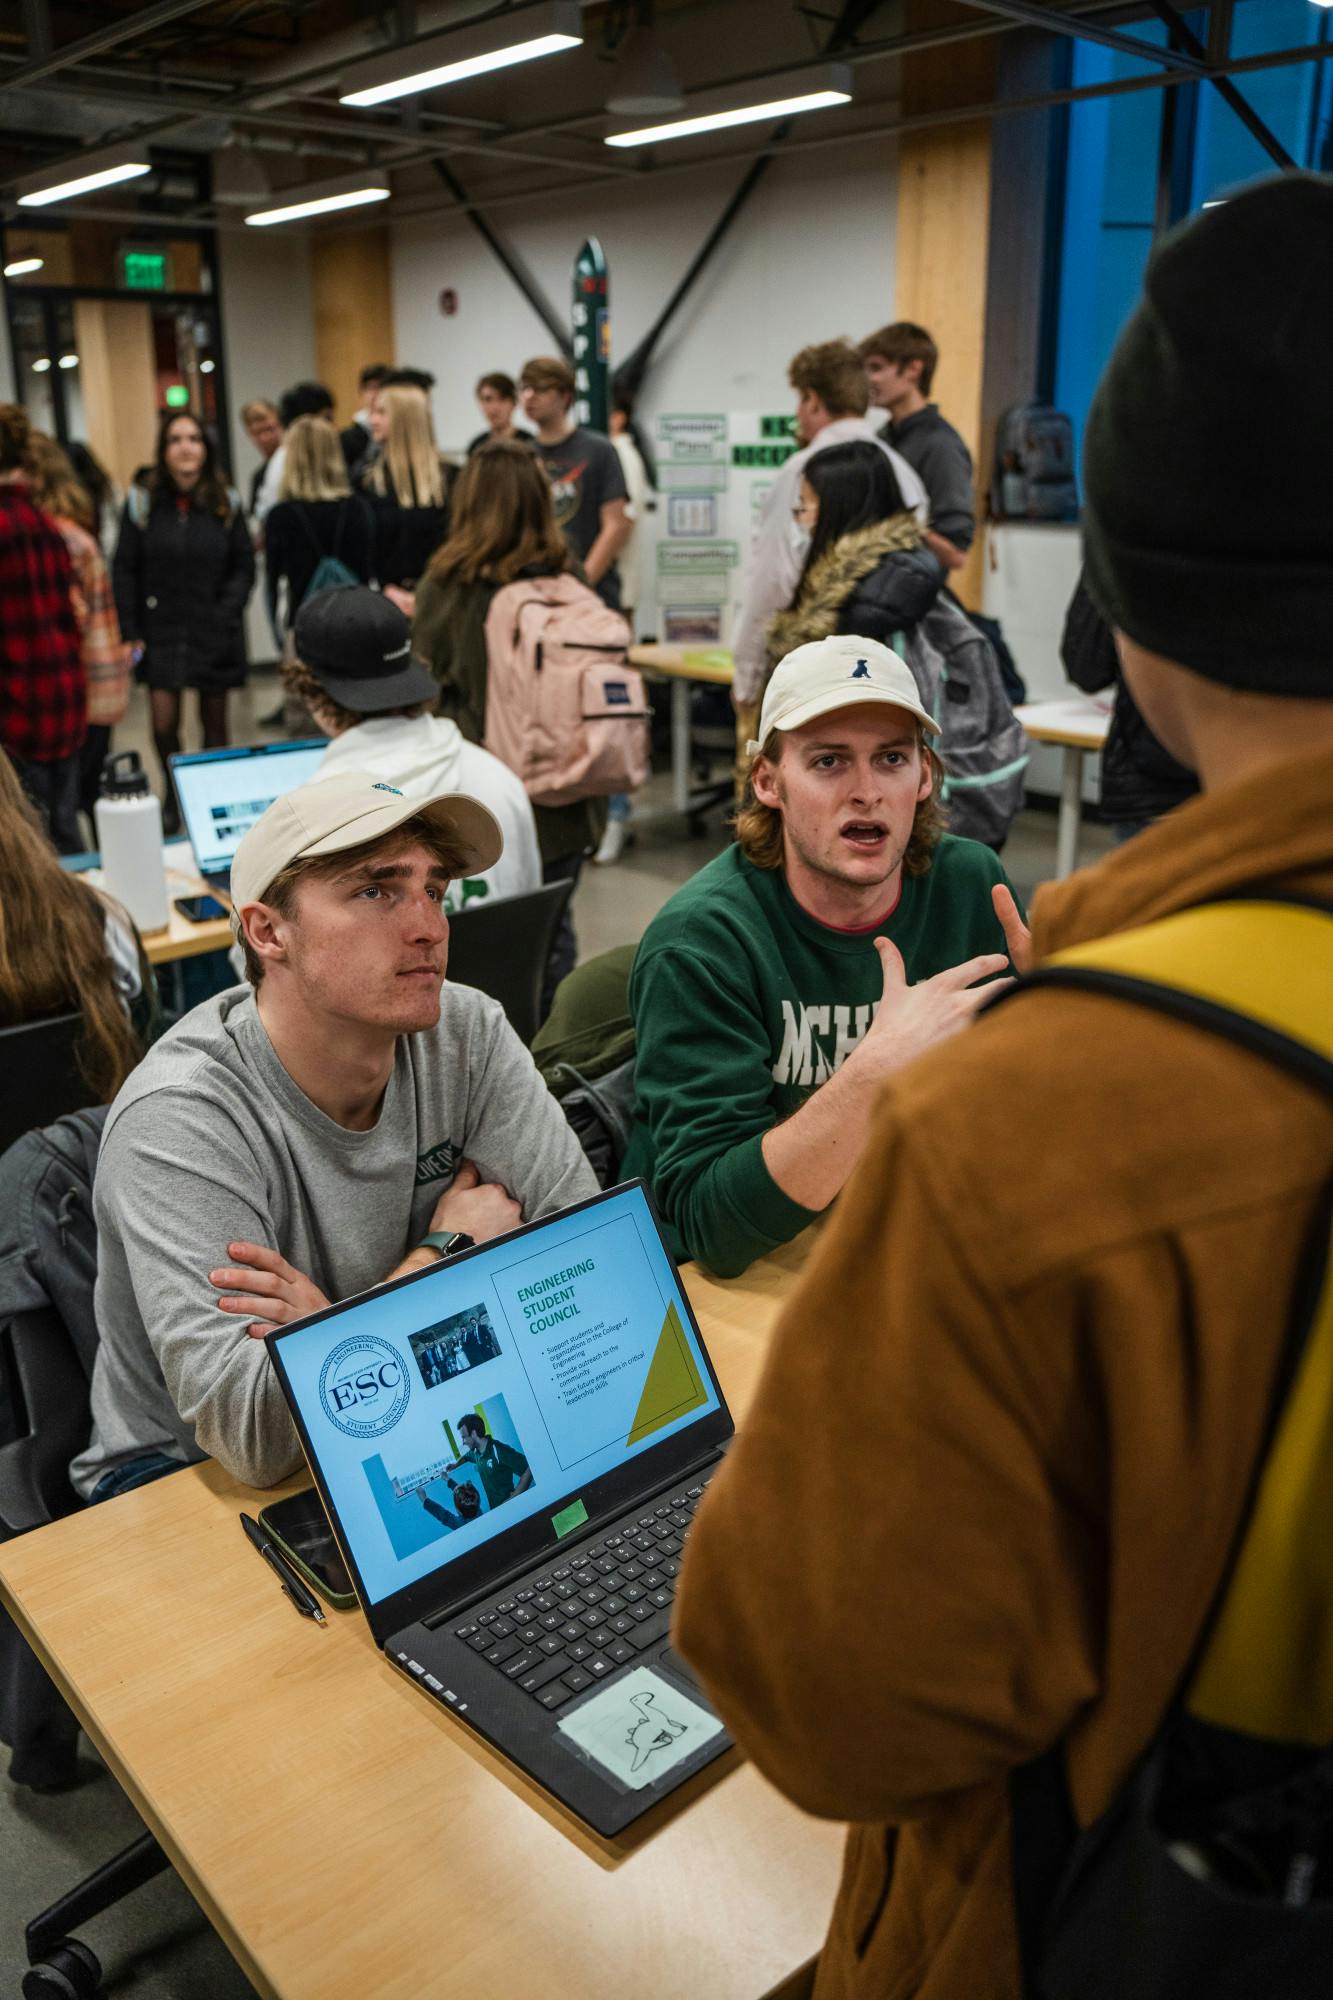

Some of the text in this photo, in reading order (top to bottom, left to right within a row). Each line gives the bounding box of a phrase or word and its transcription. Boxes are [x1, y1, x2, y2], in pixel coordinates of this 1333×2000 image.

[517, 1259, 595, 1302] ENGINEERING
[523, 1286, 575, 1319] STUDENT
[529, 1304, 581, 1334] COUNCIL
[334, 1344, 374, 1365] ENGINEERING
[547, 1322, 604, 1355] Support students and
[550, 1342, 585, 1362] organizations
[592, 1332, 602, 1340] the
[603, 1324, 622, 1337] College
[623, 1317, 629, 1326] of
[552, 1350, 585, 1370] Engineering
[556, 1344, 619, 1380] Provide outreach to the
[563, 1387, 577, 1398] Train
[577, 1378, 595, 1392] future
[596, 1365, 621, 1382] engineers
[628, 1352, 645, 1364] critical
[328, 1361, 400, 1412] ESC
[560, 1369, 590, 1388] community
[566, 1381, 608, 1406] leadership skills
[346, 1420, 377, 1430] STUDENT
[383, 1398, 401, 1423] COUNCIL
